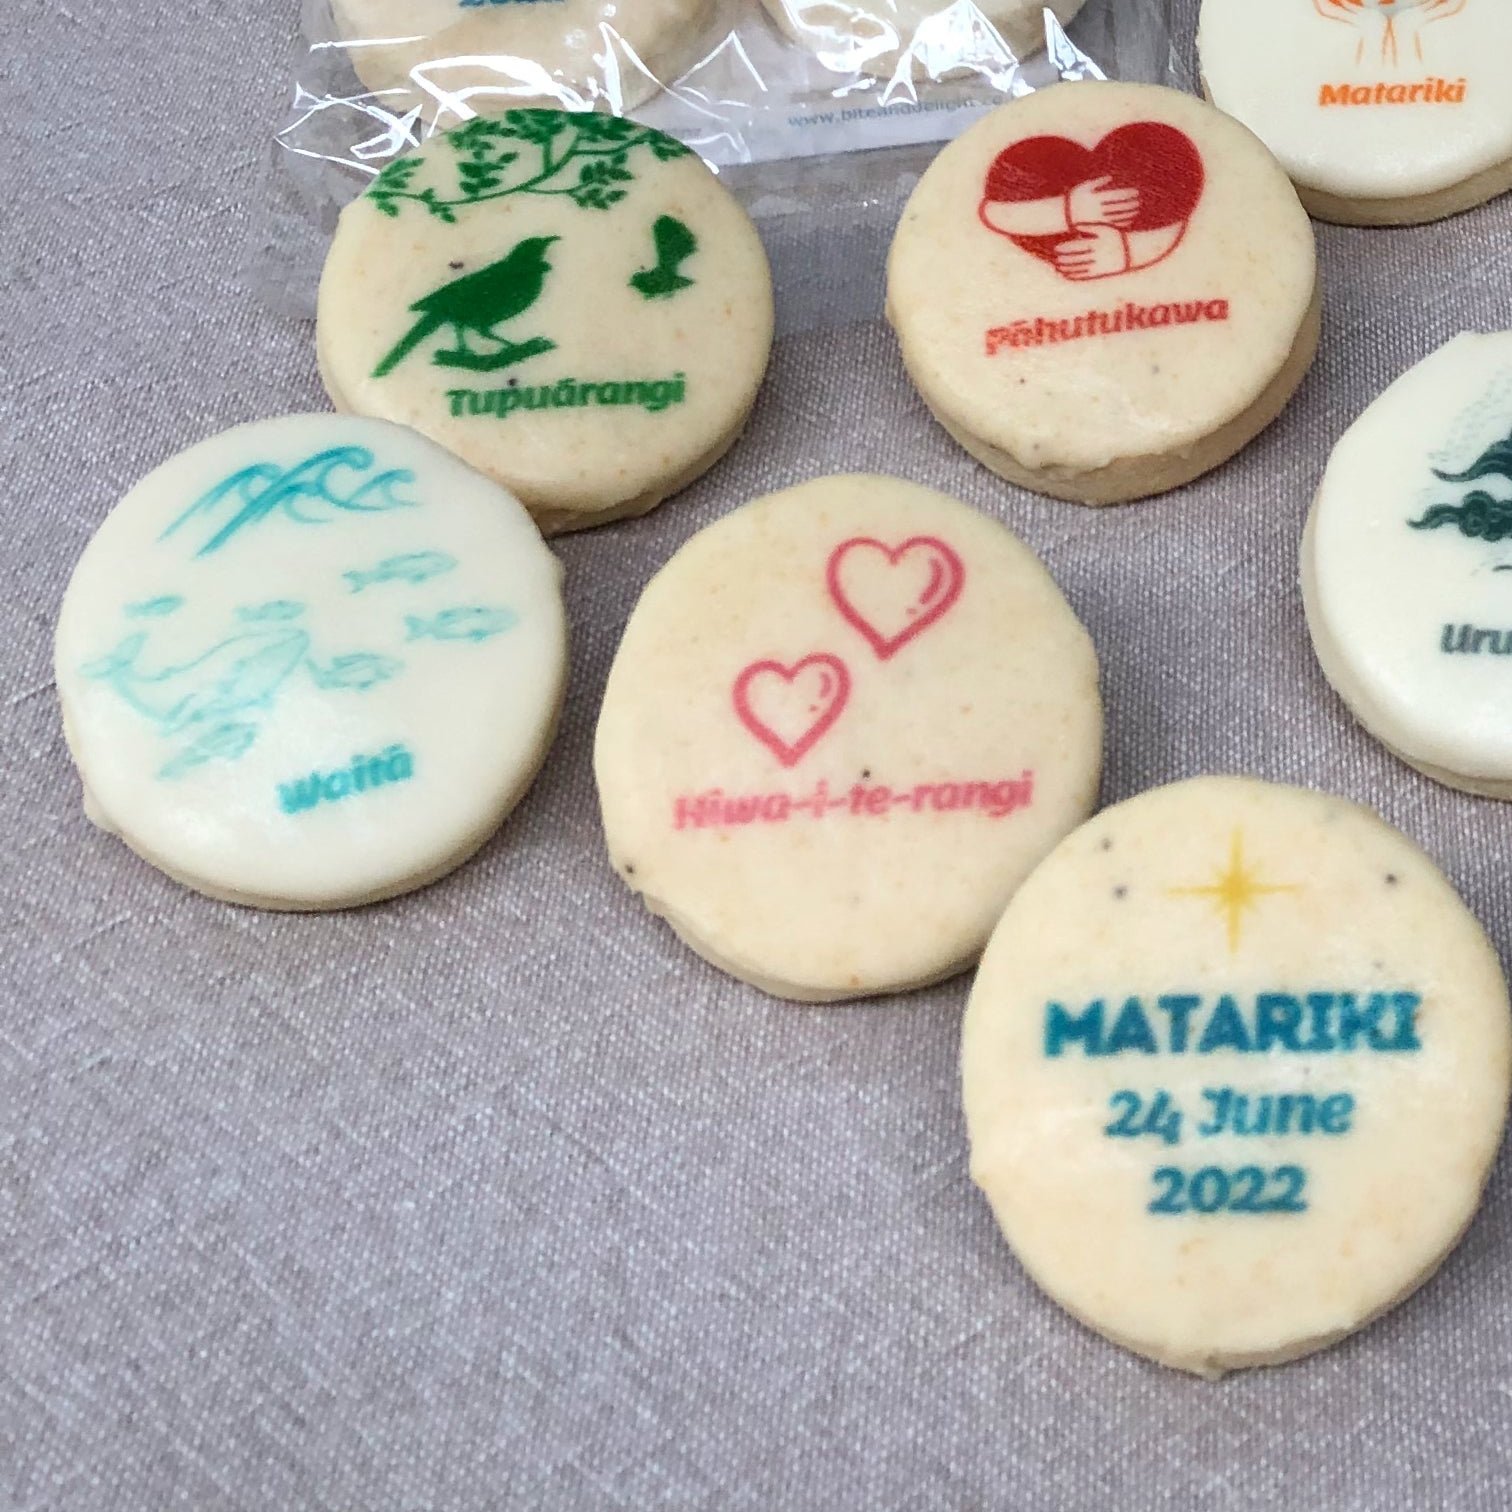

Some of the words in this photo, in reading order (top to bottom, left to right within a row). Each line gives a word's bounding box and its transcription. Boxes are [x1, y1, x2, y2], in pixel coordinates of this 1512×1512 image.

[1318, 78, 1467, 107] Matariki
[984, 297, 1230, 357] Pōhutukawa
[447, 373, 687, 419] Tupuārangi
[673, 769, 1034, 831] Hiwa-i-te-rangi
[1043, 991, 1421, 1058] MATARIKI
[1104, 1090, 1184, 1146] 24
[1200, 1087, 1356, 1139] June
[1147, 1165, 1308, 1216] 2022
